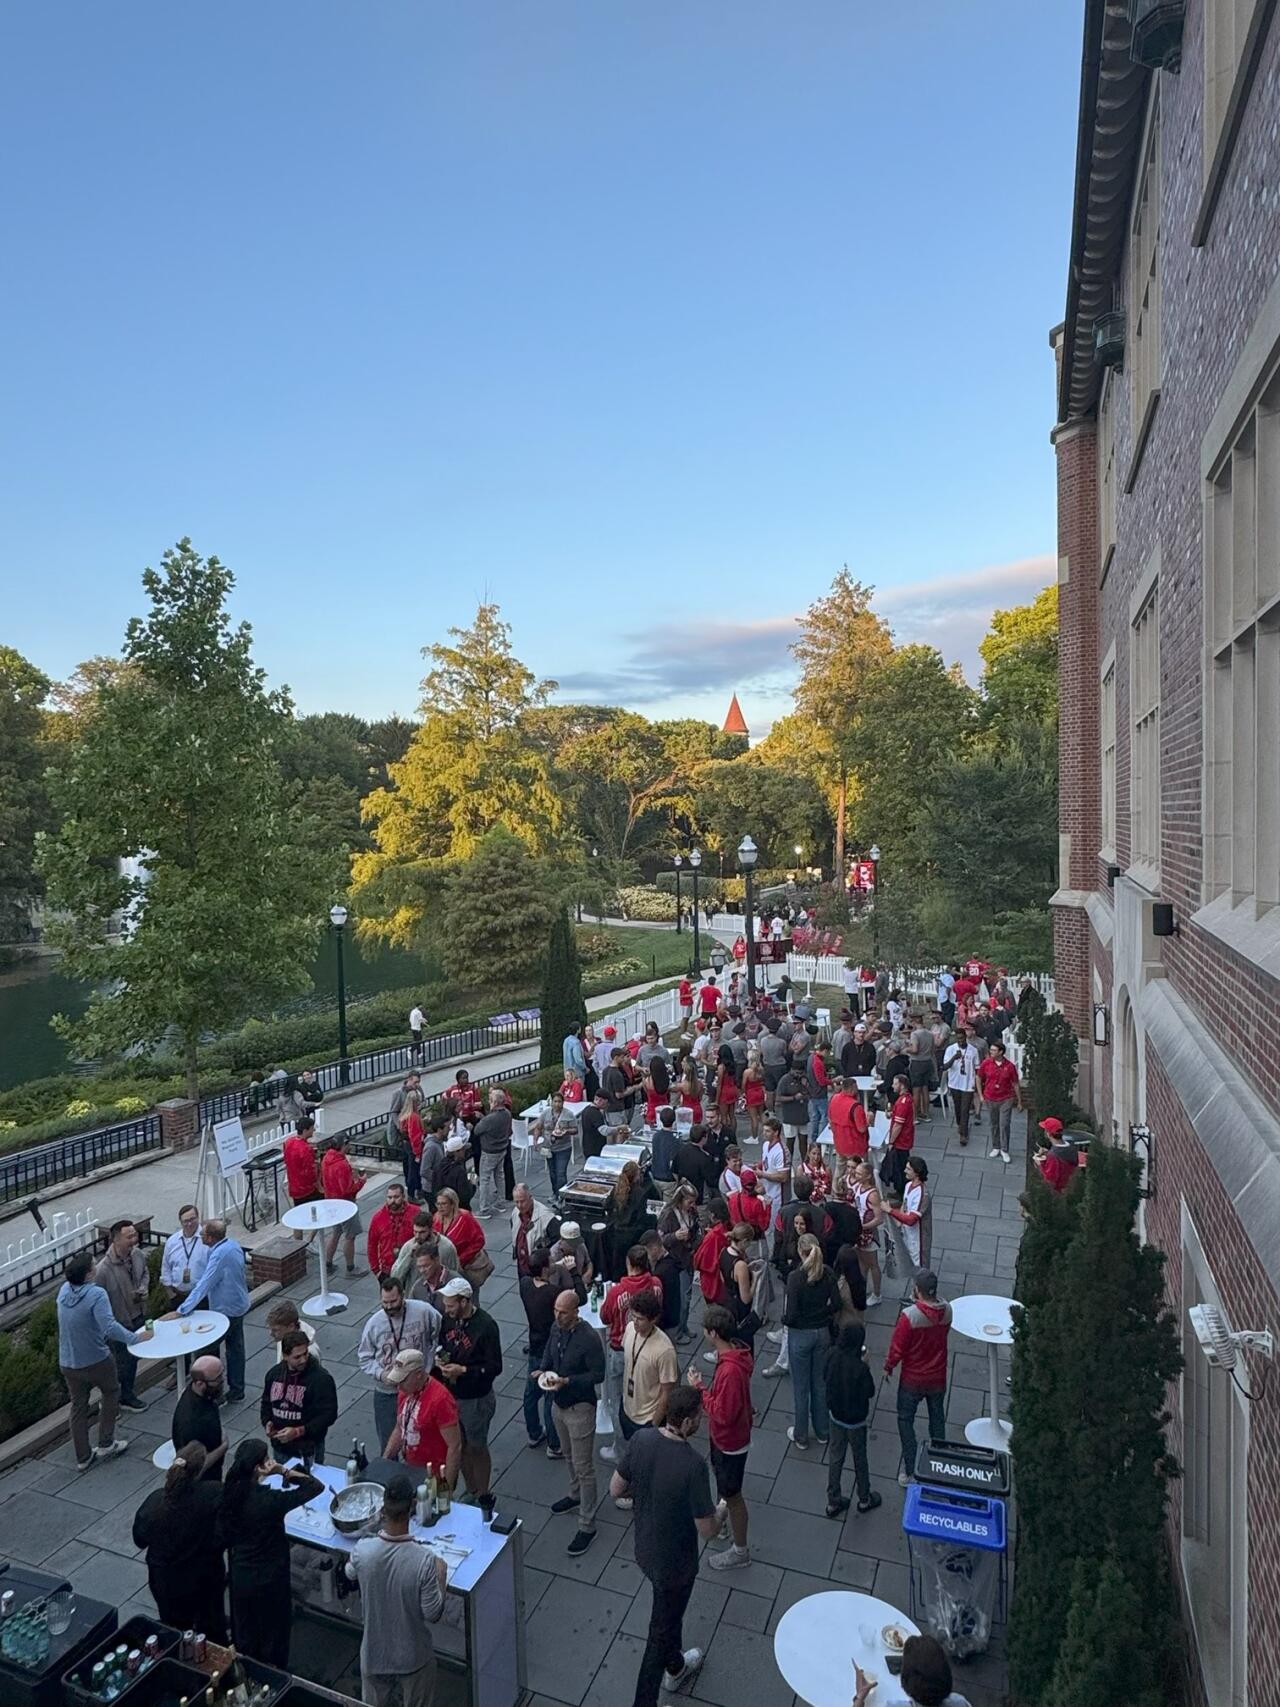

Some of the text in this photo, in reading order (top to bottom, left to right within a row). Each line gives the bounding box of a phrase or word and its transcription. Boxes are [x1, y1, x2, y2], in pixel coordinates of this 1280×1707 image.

[929, 1460, 993, 1482] TRASH ONLY
[919, 1512, 988, 1536] RECYCLABLES
